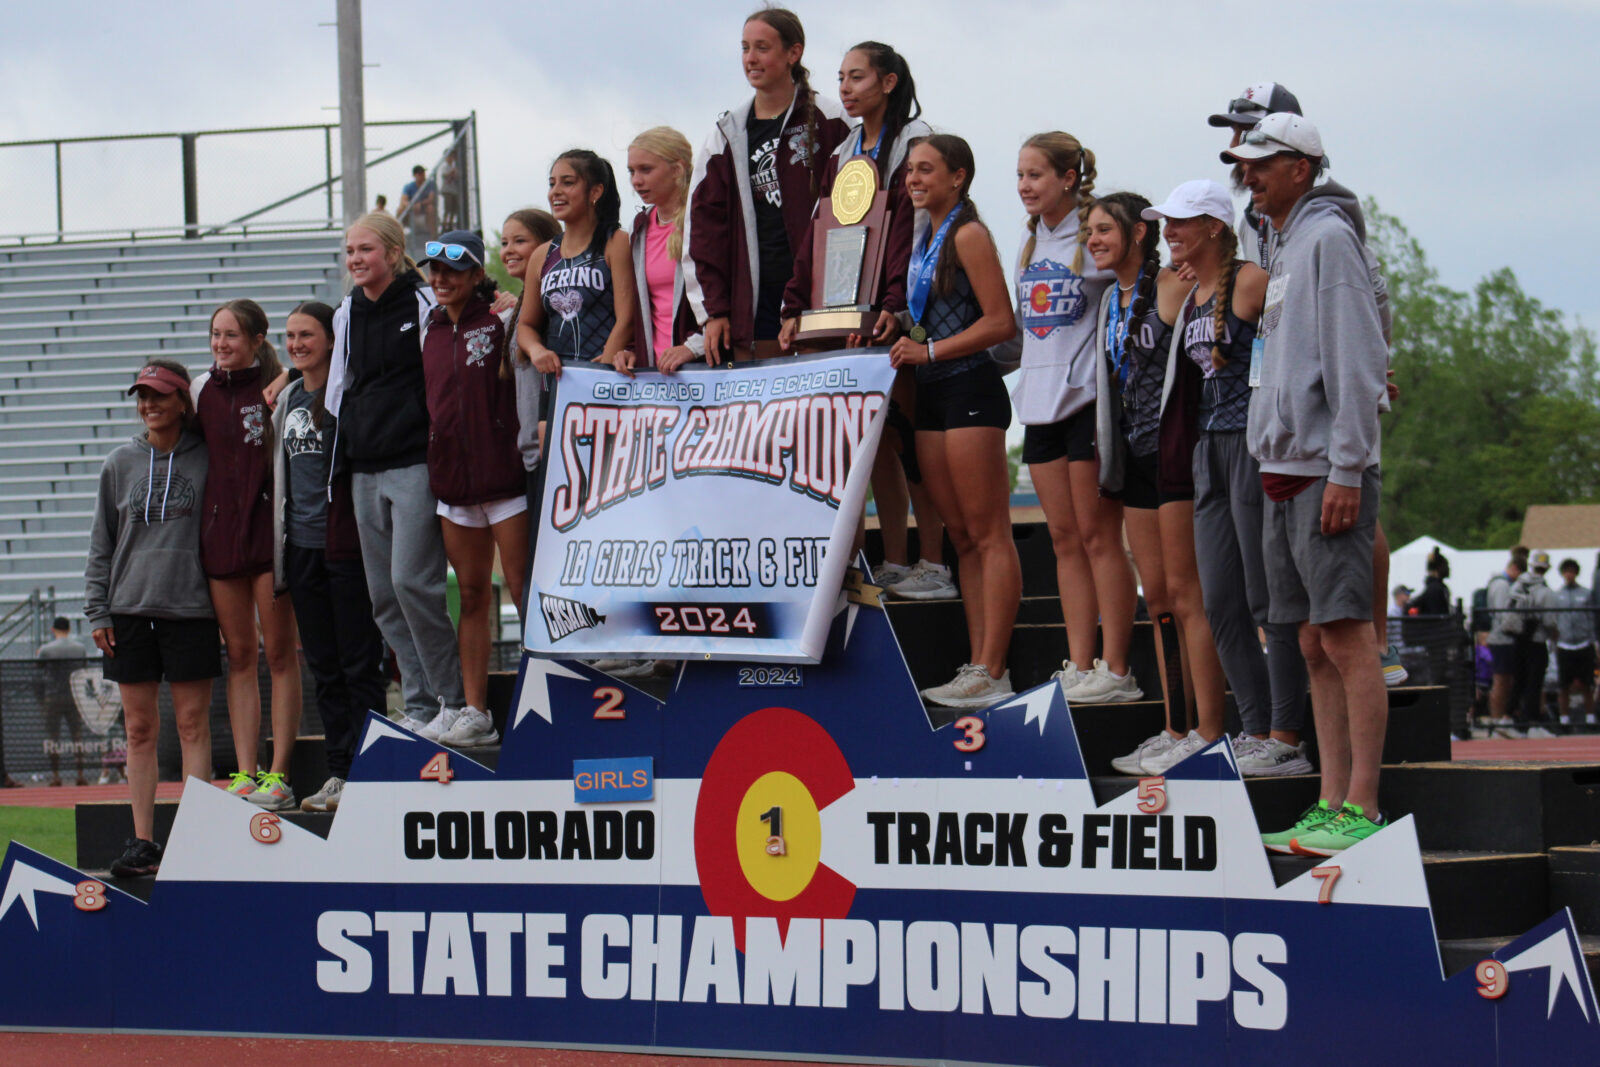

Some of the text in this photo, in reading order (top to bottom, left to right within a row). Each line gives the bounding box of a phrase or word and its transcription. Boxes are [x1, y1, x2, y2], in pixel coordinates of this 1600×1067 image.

[592, 368, 858, 401] COLORADO HIGH SCHOOL
[551, 402, 682, 533] STATE
[560, 539, 591, 588] 1A
[591, 538, 668, 588] GIRLS
[669, 538, 751, 588] TRACK
[757, 538, 778, 588] &
[543, 596, 590, 640] CHSAA
[655, 606, 757, 634] 2024
[739, 666, 801, 686] 2024
[592, 686, 626, 719] 2
[42, 739, 109, 754] Runners
[952, 715, 986, 752] 3
[419, 752, 454, 784] 4
[575, 769, 649, 791] GIRLS
[1137, 776, 1167, 814] 5
[249, 812, 282, 844] 6
[403, 810, 655, 861] COLORADO
[866, 811, 1218, 871] TRACK & FIELD
[73, 880, 107, 911] 8
[1311, 866, 1341, 904] 7
[316, 910, 1288, 1031] STATE CHAMPIONSHIPS
[1475, 960, 1509, 999] 9
